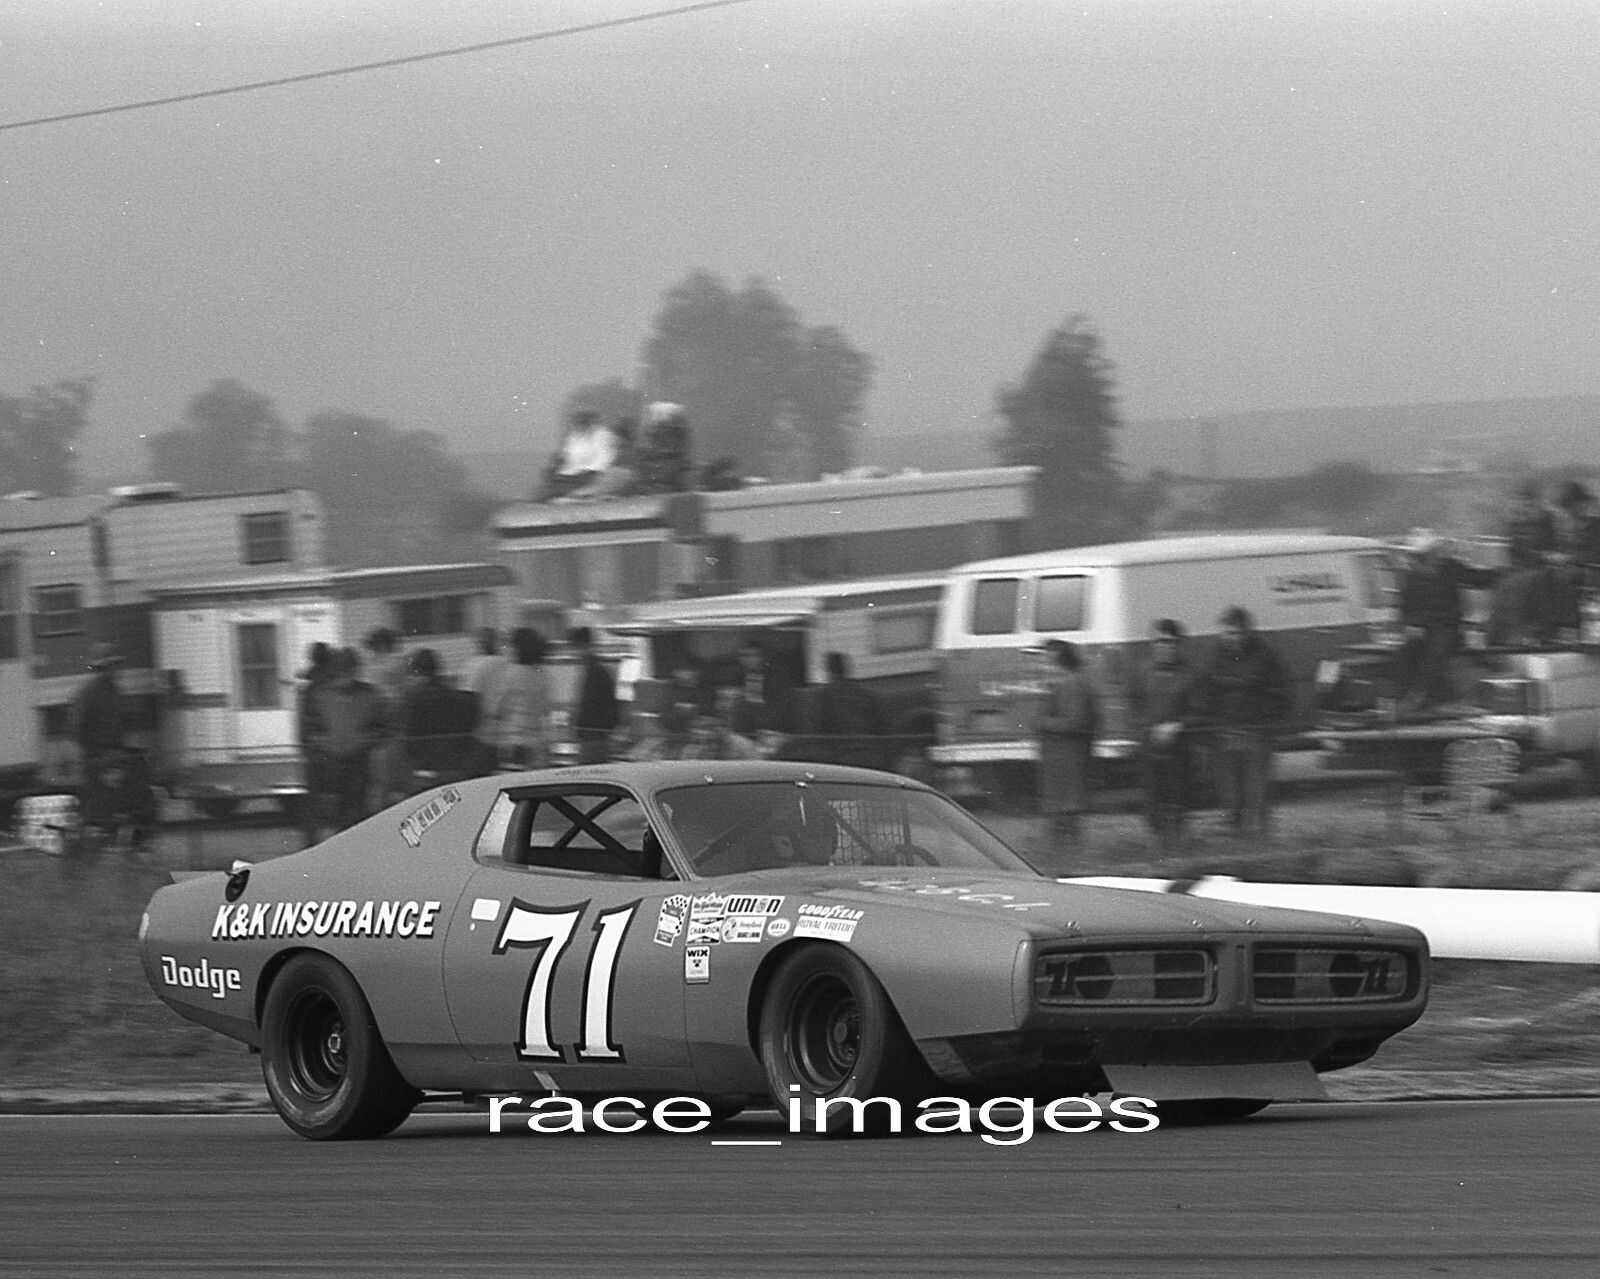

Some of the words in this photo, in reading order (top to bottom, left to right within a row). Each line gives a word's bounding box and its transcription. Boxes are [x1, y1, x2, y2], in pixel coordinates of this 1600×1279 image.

[212, 902, 271, 939] K&K
[271, 900, 440, 938] INSURANCE
[798, 903, 865, 920] GOODYEAR
[690, 926, 720, 935] CHAMPION
[797, 918, 822, 929] ROYAL
[687, 949, 708, 957] WIX
[161, 955, 241, 999] Dodge
[494, 898, 642, 1063] 71
